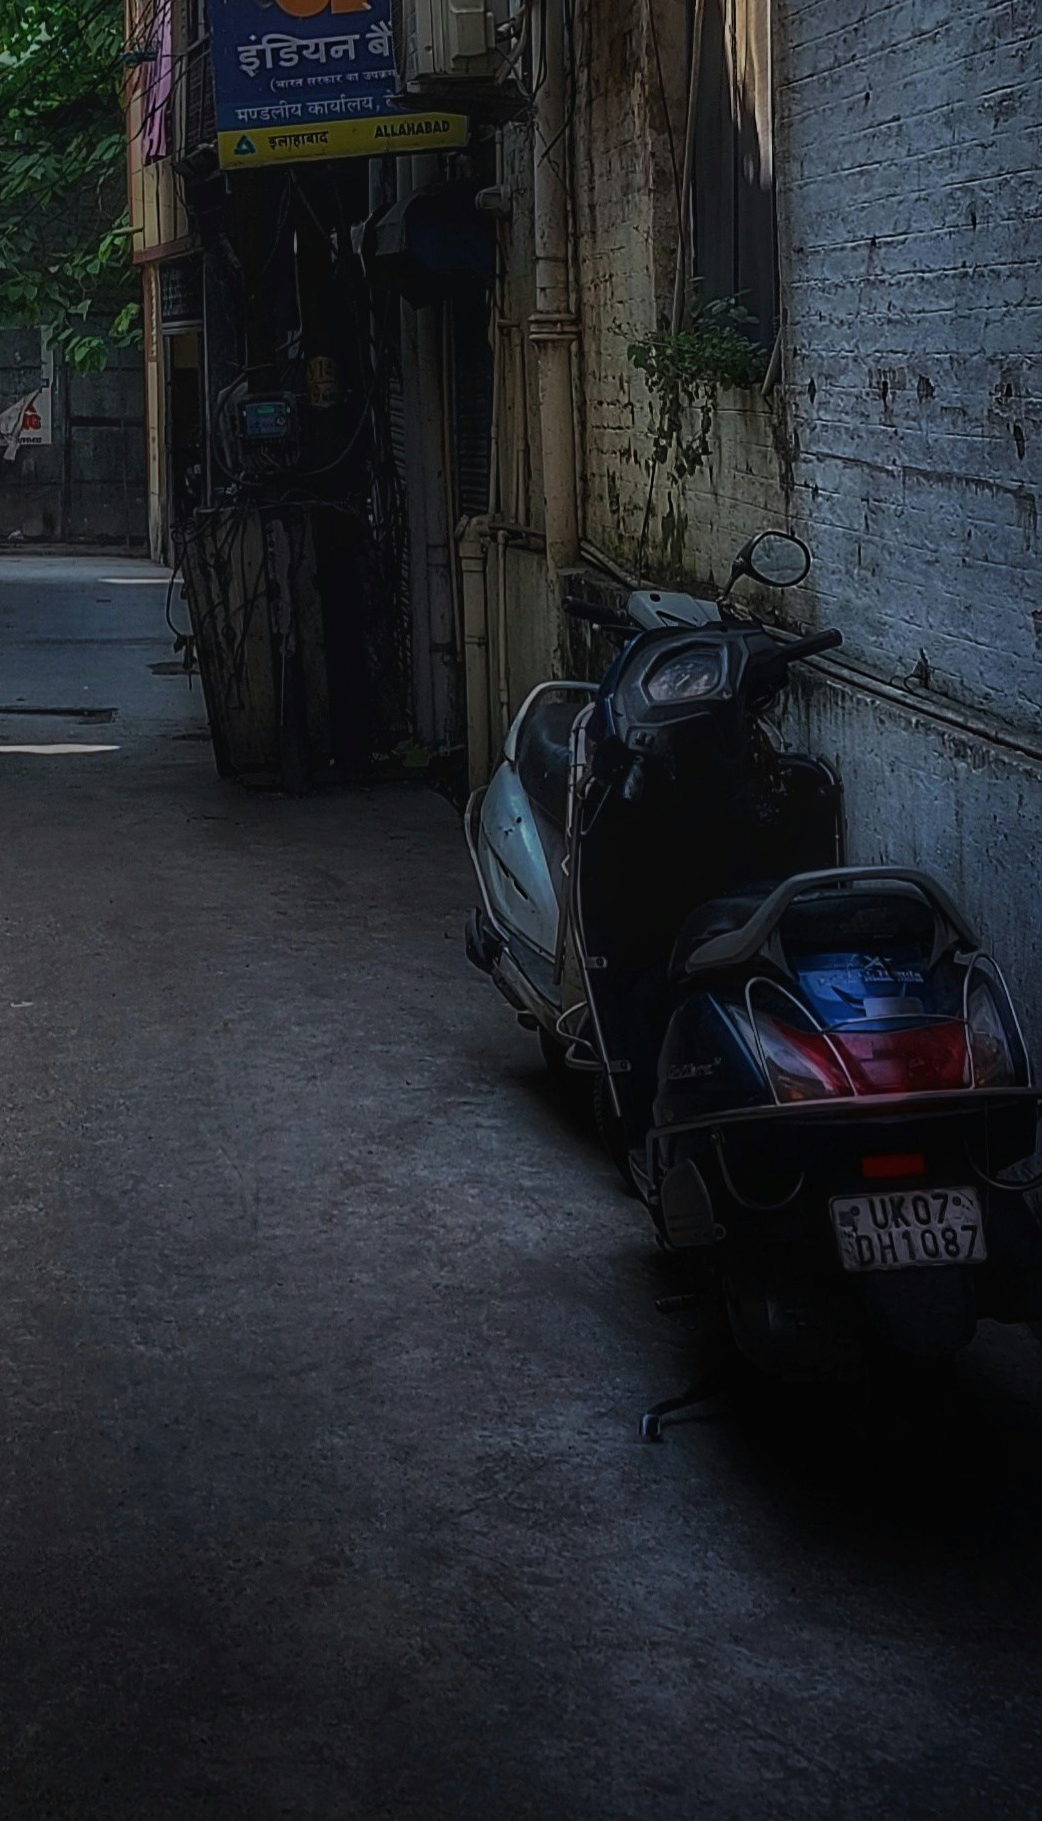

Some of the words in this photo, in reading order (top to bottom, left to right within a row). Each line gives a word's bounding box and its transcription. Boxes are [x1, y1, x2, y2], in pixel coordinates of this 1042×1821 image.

[237, 32, 360, 78] इंडियन
[235, 99, 303, 123] मण्डलीय
[374, 120, 451, 139] ALLAHABAD
[868, 1192, 949, 1229] UK07
[857, 1224, 978, 1265] DH1087
